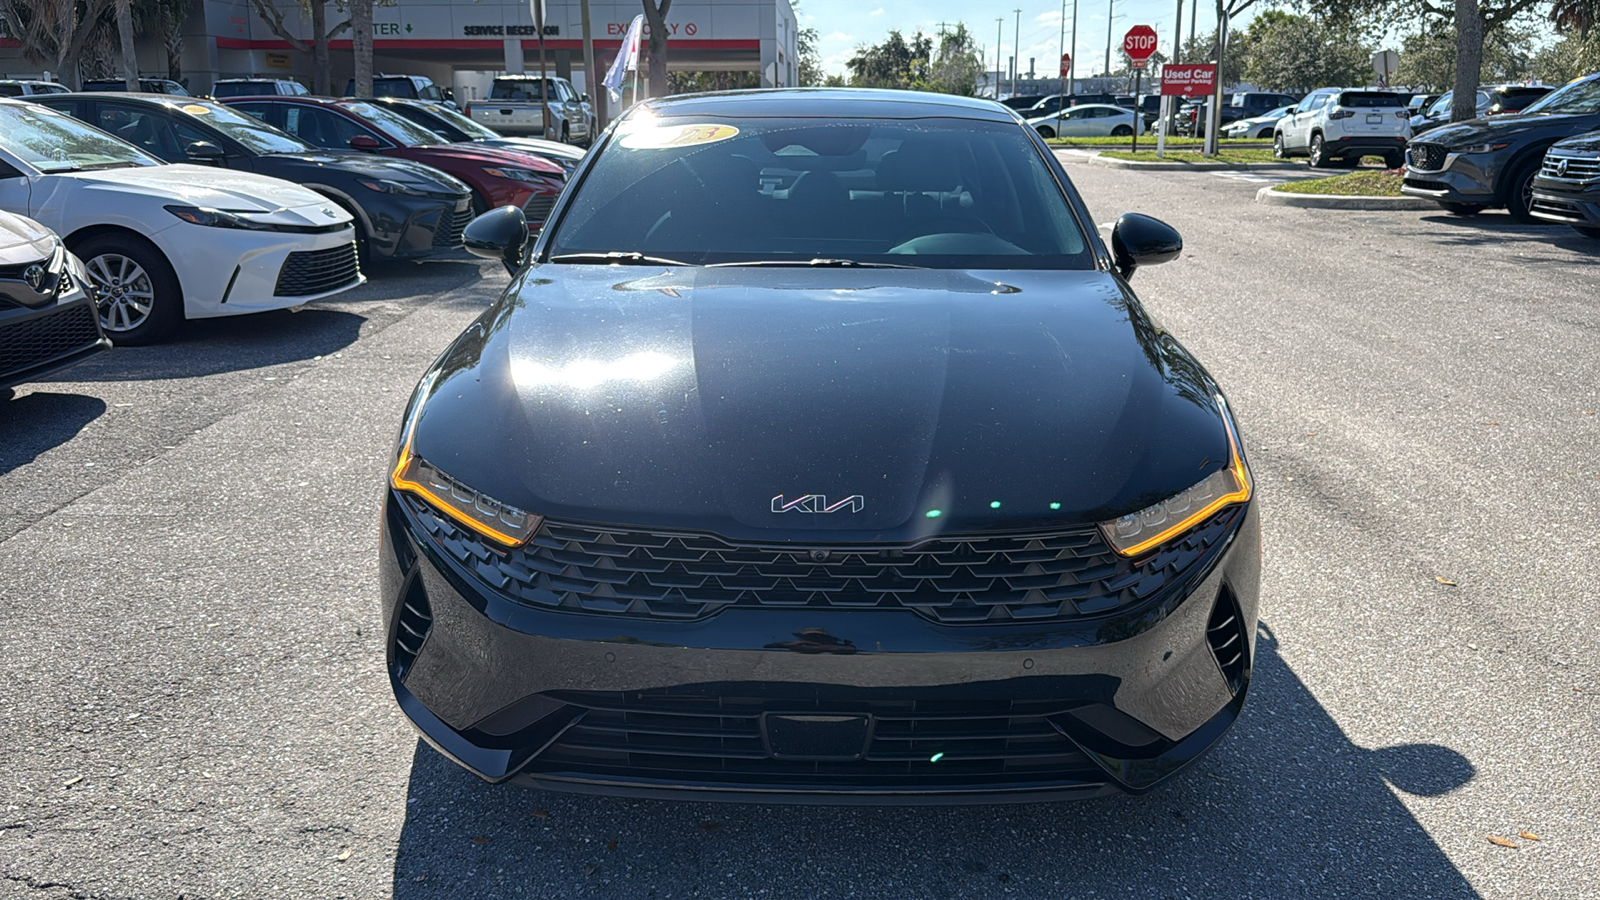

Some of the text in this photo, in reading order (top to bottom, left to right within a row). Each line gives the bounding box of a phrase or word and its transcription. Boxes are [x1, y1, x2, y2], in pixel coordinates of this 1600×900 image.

[372, 23, 400, 35] TER
[463, 25, 559, 36] SERVICE RECEPION
[607, 23, 679, 35] EXI OY
[1126, 35, 1156, 49] STOP
[1164, 69, 1213, 79] Used Car
